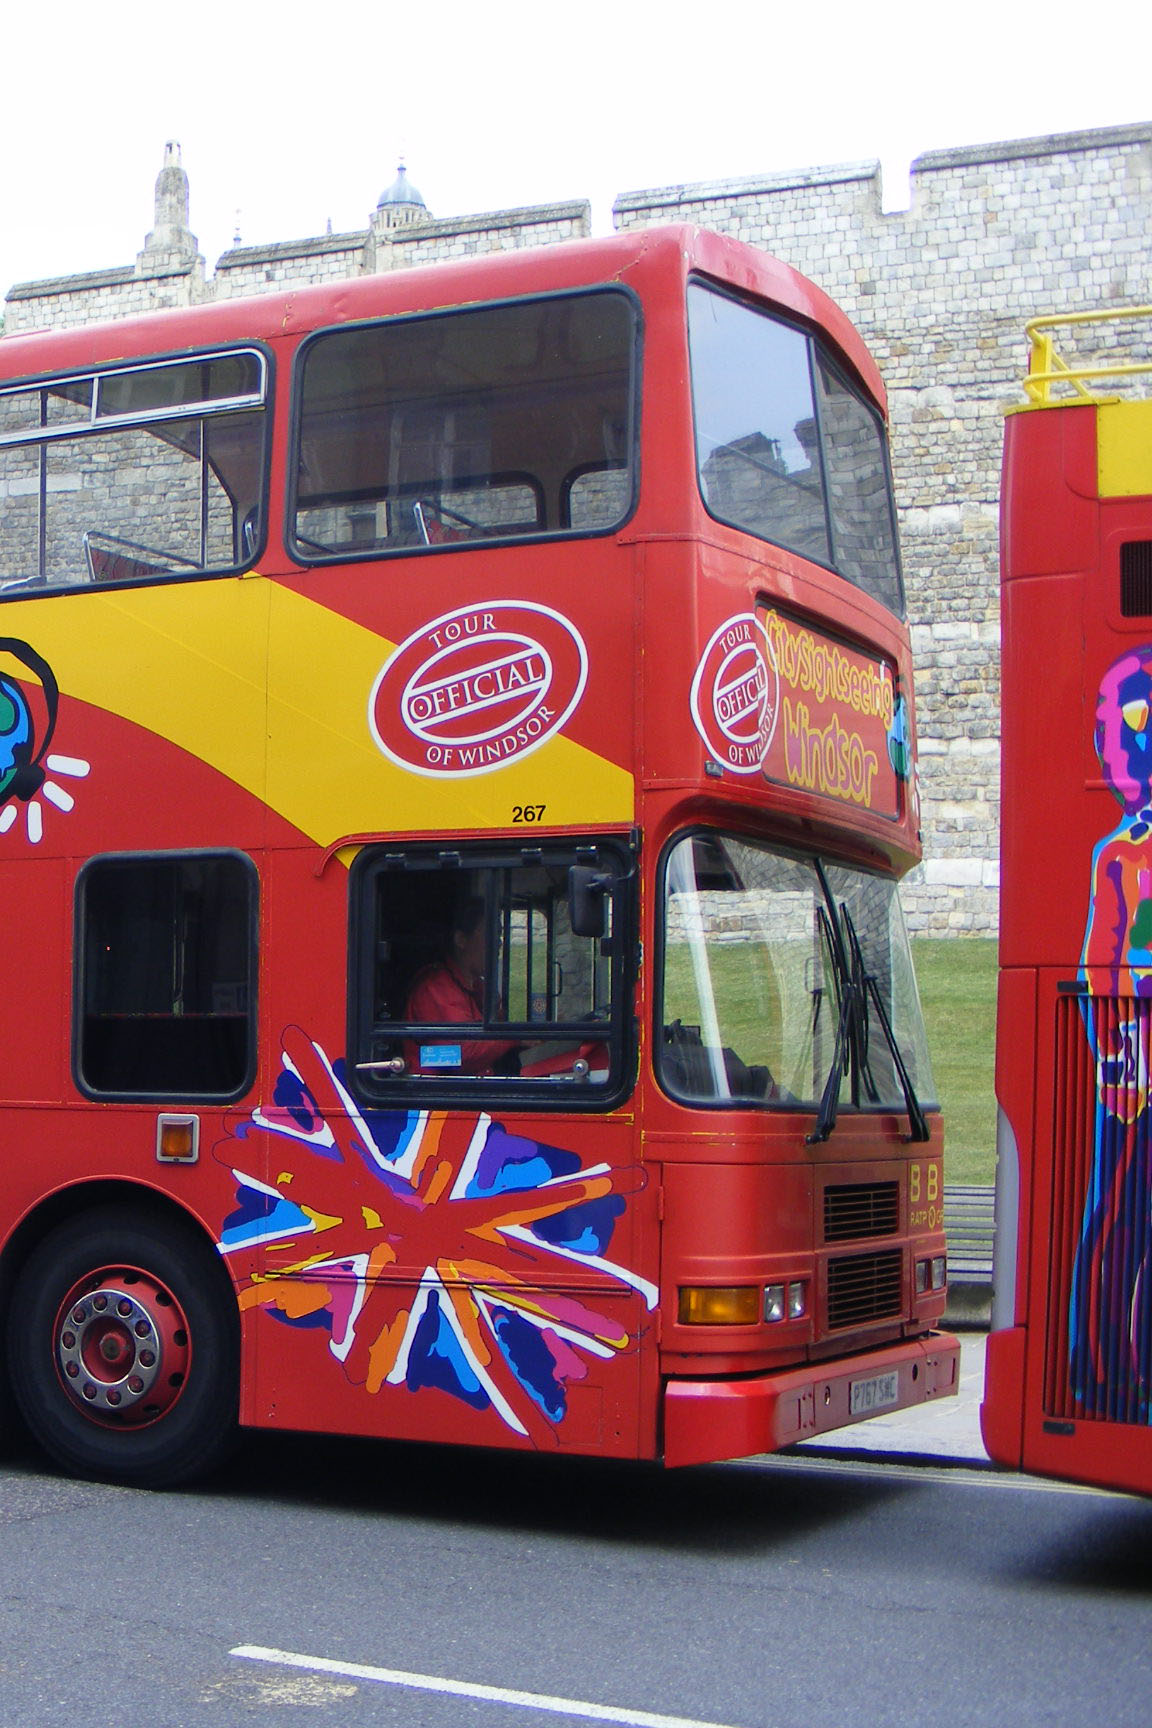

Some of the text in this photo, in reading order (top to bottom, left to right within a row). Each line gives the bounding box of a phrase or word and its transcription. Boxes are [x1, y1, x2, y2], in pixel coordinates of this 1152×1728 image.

[428, 613, 497, 649] TOUR
[719, 624, 752, 654] TOUR
[409, 658, 543, 721] OFFICIAL
[718, 666, 766, 721] OFFICL
[426, 704, 556, 767] OF WINDSOR
[729, 702, 775, 764] OF WISOR
[783, 696, 879, 808] Windsor
[511, 804, 547, 823] 267
[910, 1209, 928, 1226] RATP
